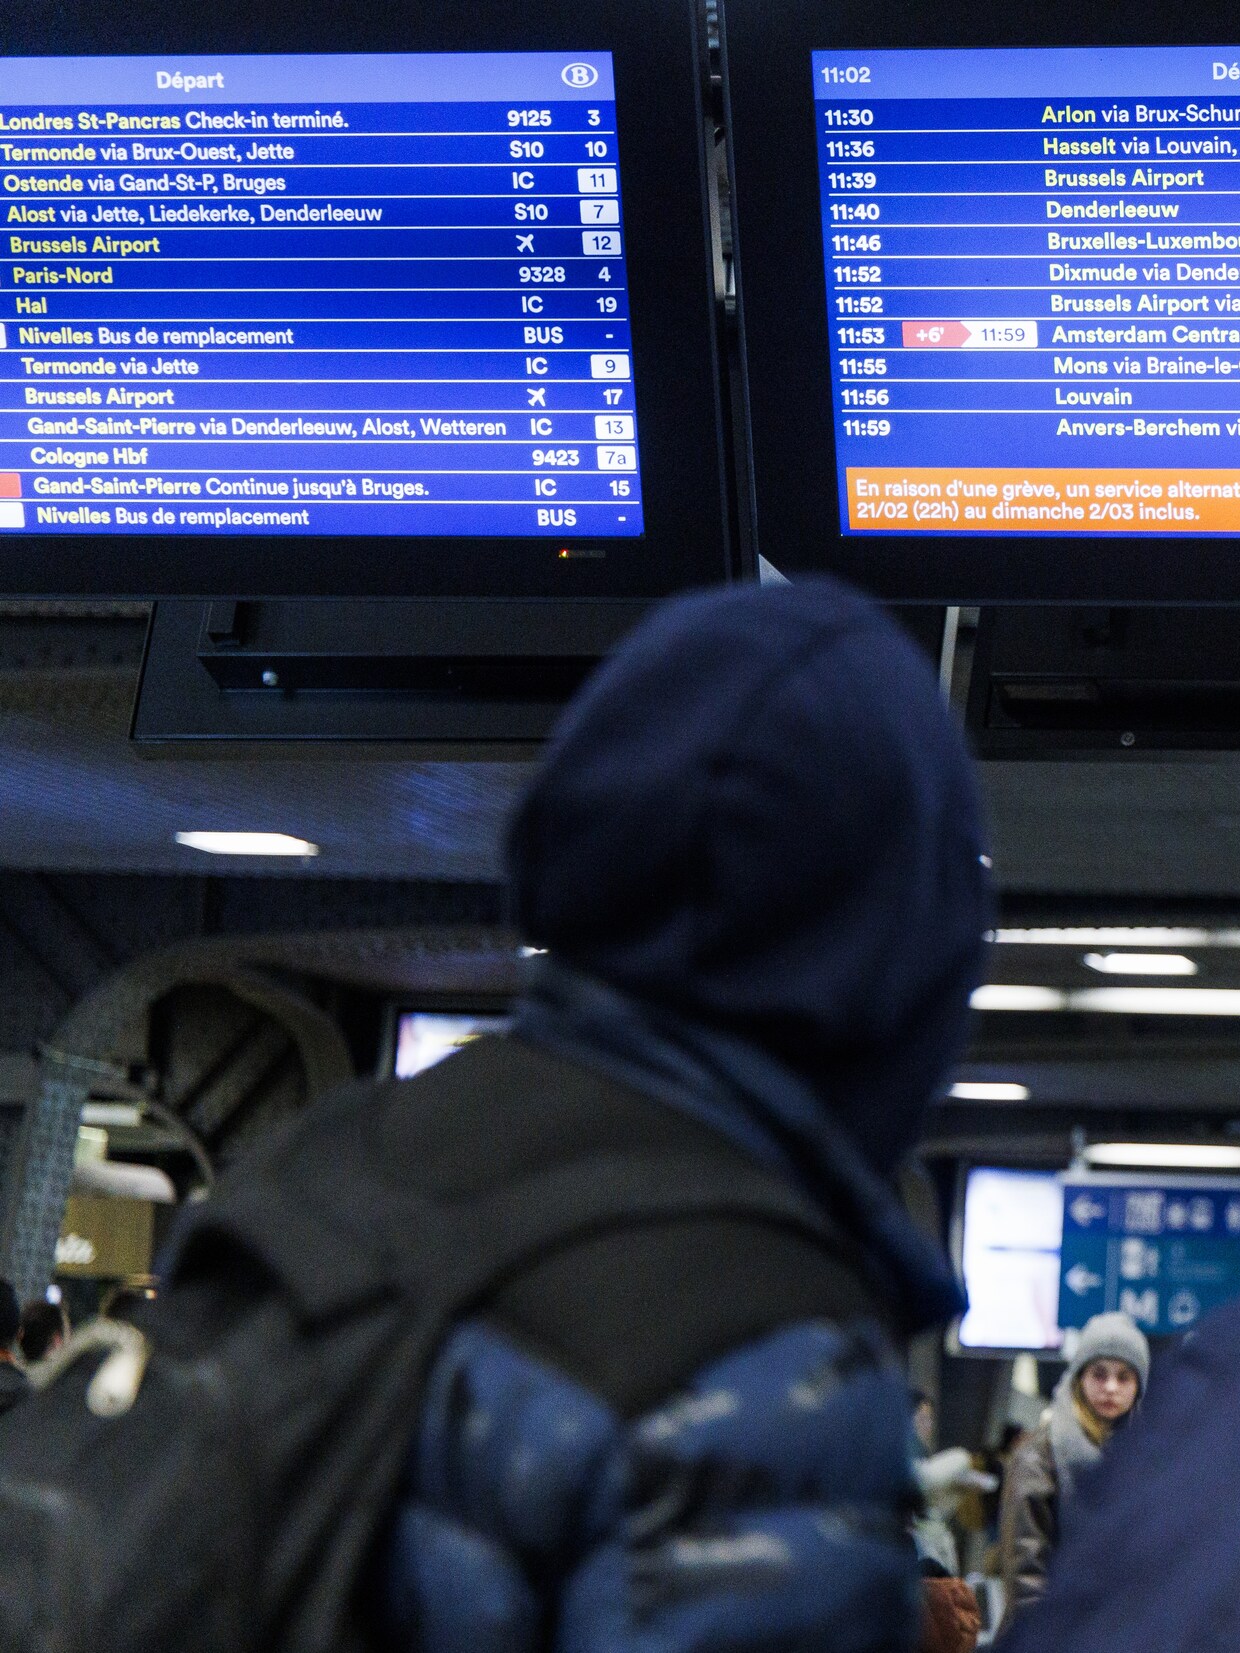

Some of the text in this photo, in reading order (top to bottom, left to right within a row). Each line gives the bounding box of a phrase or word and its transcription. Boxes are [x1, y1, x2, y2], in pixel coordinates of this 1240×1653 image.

[156, 71, 224, 92] Départ
[821, 67, 871, 83] 11:02
[0, 110, 349, 130] Londres St-Pancras Check-in terminé.
[507, 110, 552, 127] 9125
[825, 109, 873, 125] 11:30
[1042, 105, 1096, 123] Arlon
[1101, 105, 1129, 122] via
[0, 142, 294, 162] Termonde via Brux-Ouest, Jette
[826, 141, 875, 157] 11:36
[1044, 137, 1116, 155] Hasselt
[1121, 136, 1149, 154] via
[1156, 136, 1237, 156] Louvain,
[4, 173, 286, 195] Ostende via Gand-St-P, Bruges
[828, 172, 876, 189] 11:39
[7, 204, 382, 225] Alost via Jette, Liedekerke, Denderleeuw
[830, 203, 880, 220] 11:40
[832, 235, 881, 251] 11:46
[13, 266, 113, 284] Paris-Nord
[519, 266, 565, 282] 9328
[834, 266, 881, 282] 11:52
[1050, 263, 1137, 281] Dixmude
[1142, 263, 1170, 281] via
[16, 296, 48, 314] Hal
[19, 327, 294, 348] Nivelles Bus de remplacement
[837, 328, 885, 344] 11:53
[982, 328, 1025, 341] 11:59
[1052, 325, 1167, 343] Amsterdam
[839, 358, 887, 375] 11:55
[1054, 357, 1108, 374] Mons
[1113, 356, 1141, 374] via
[841, 389, 889, 405] 11:56
[1055, 387, 1132, 405] Louvain
[27, 417, 506, 438] Gand-Saint-Pierre via Denderleeuw, Alost, Wetteren
[843, 420, 891, 436] 11:59
[1057, 418, 1220, 436] Anvers-Berchem
[30, 447, 148, 468] Cologne Hbf
[532, 449, 579, 466] 9423
[33, 477, 429, 499] Gand-Saint-Pierre Continue jusqu'à Bruges.
[856, 478, 880, 497] En
[884, 479, 941, 497] raison
[945, 479, 998, 497] d'une
[1002, 480, 1061, 503] grève,
[1066, 484, 1090, 498] un
[1094, 480, 1163, 498] service
[856, 500, 1200, 522] 21/02 (22h) au dimanche 2/03 inclus.
